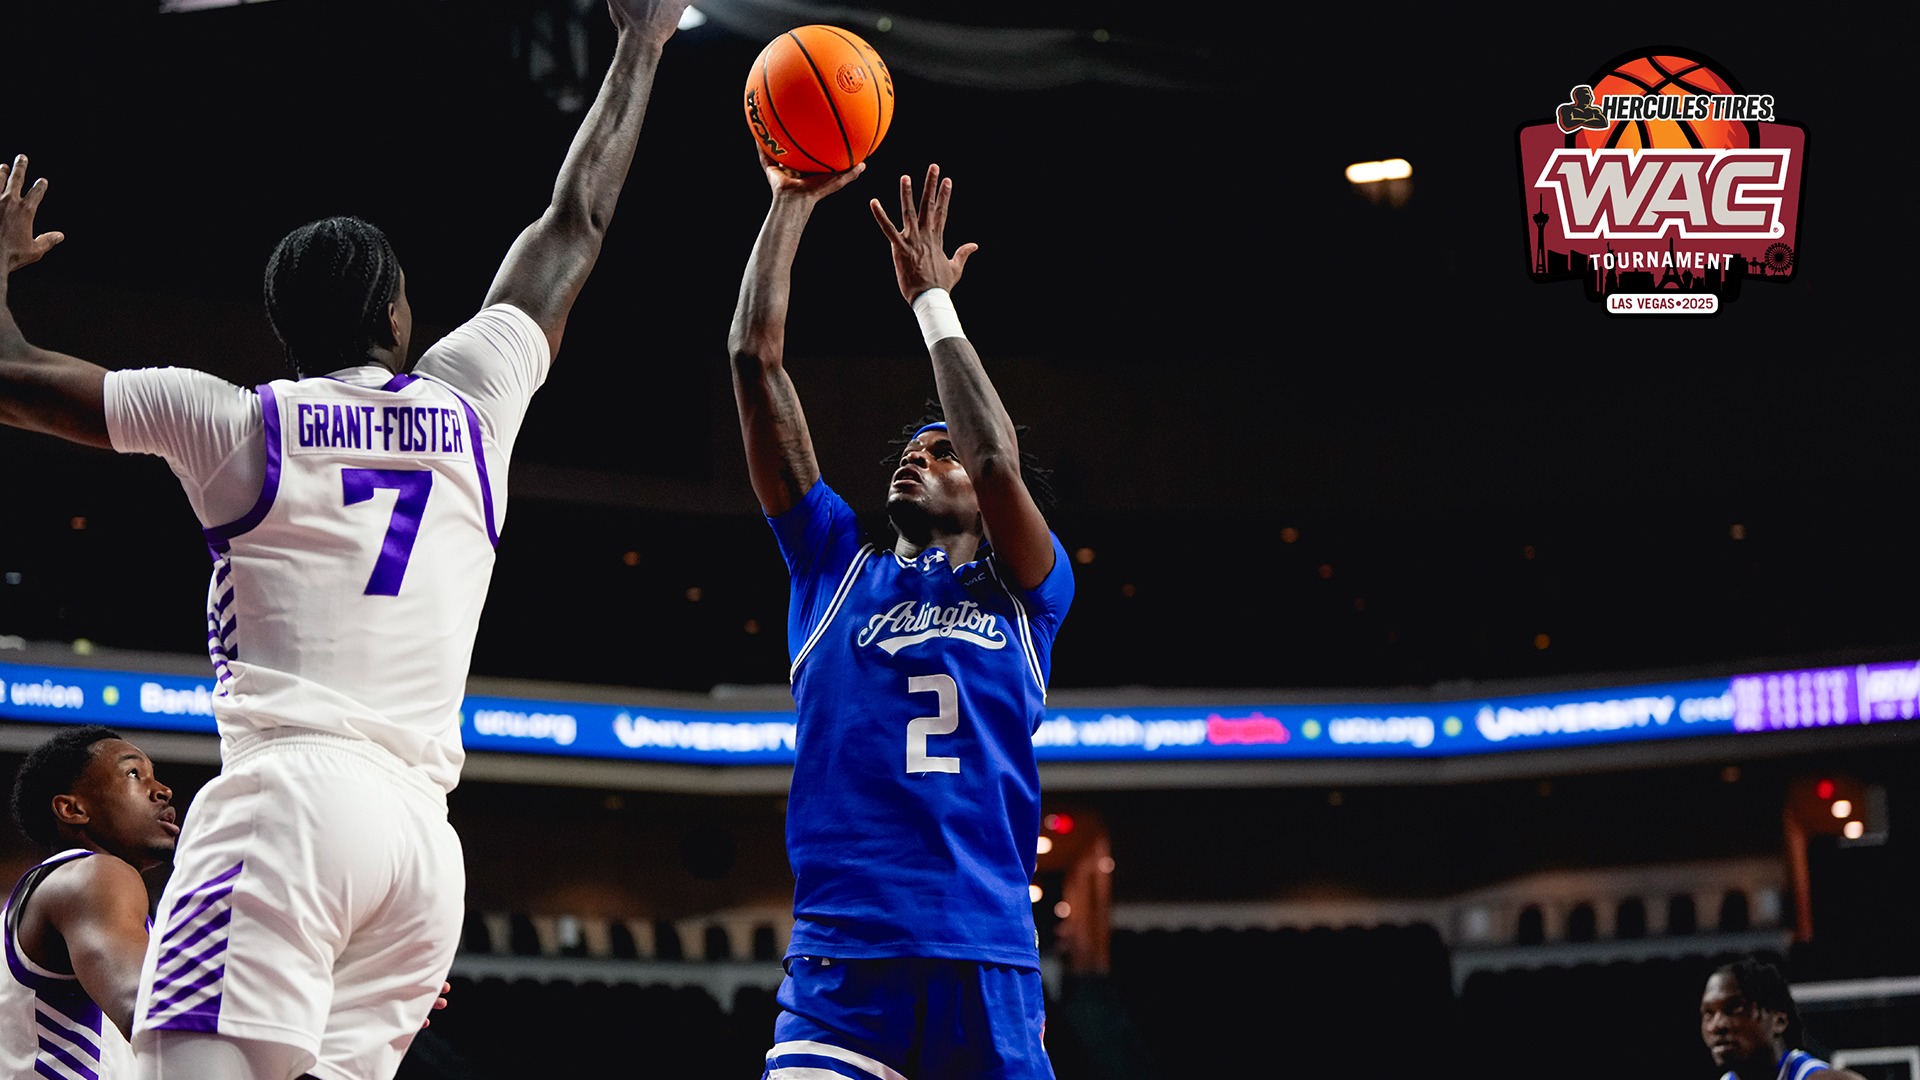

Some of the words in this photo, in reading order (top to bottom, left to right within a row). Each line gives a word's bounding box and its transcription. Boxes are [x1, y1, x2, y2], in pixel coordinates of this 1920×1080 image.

[747, 89, 787, 155] NCAA
[298, 403, 464, 454] GRANT-FOSTER
[341, 468, 433, 597] 7
[858, 601, 1007, 650] Arlington
[11, 679, 84, 709] union
[1476, 697, 1675, 741] UNIVERSITY
[906, 674, 960, 774] 2
[1078, 714, 1145, 746] with
[1144, 719, 1207, 751] your
